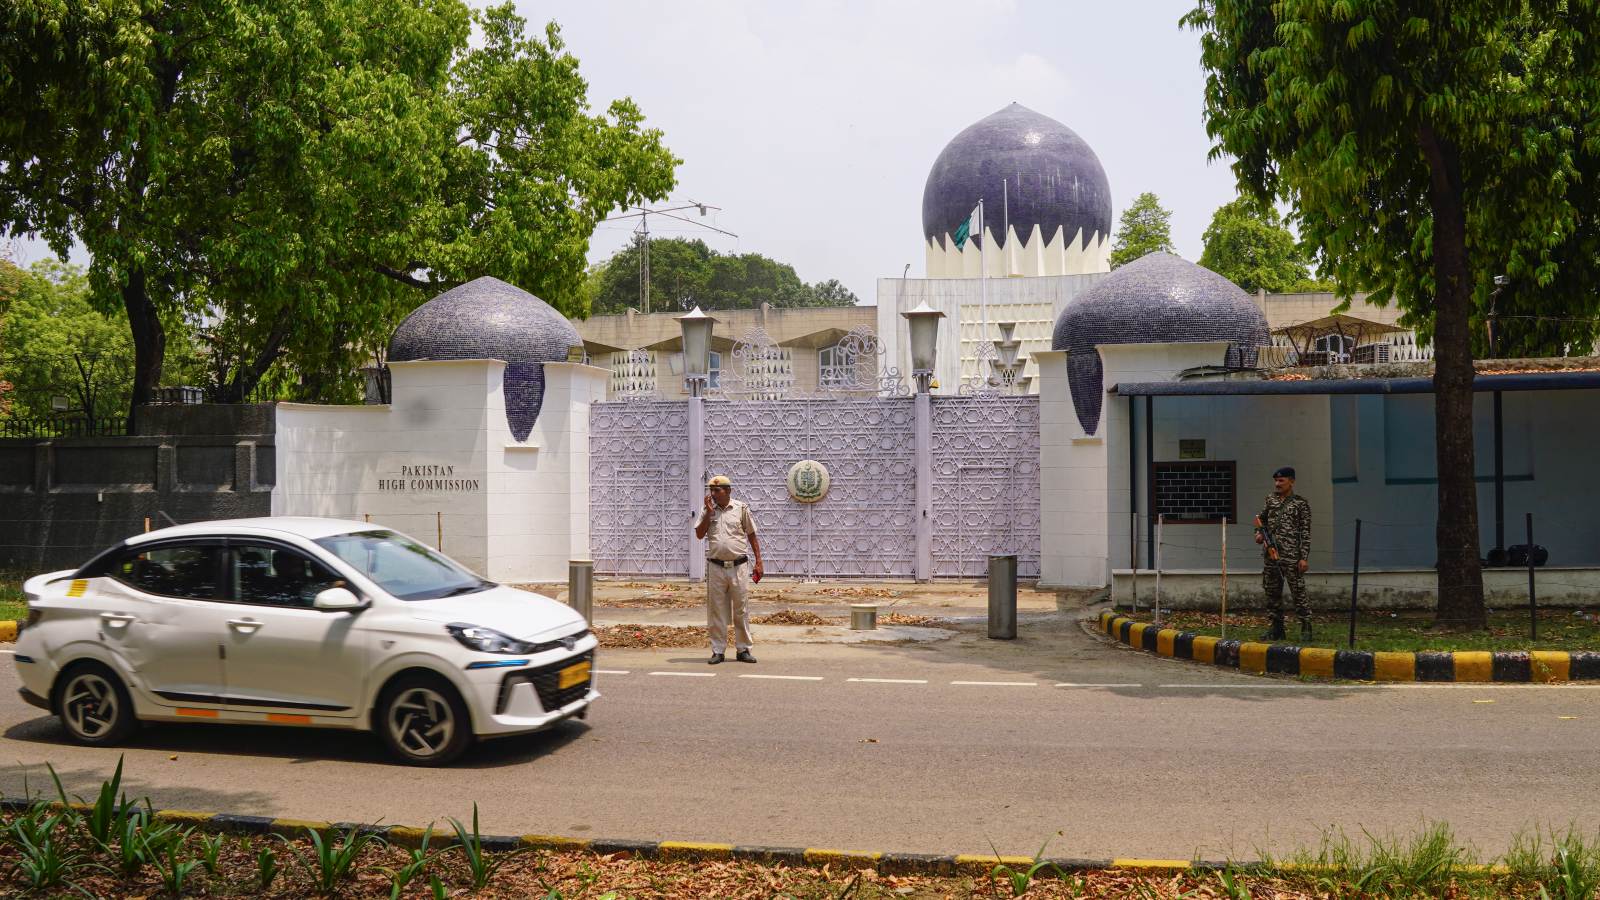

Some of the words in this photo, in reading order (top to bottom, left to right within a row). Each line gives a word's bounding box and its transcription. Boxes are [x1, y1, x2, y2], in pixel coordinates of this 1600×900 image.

[402, 465, 454, 476] PAKISTAN
[379, 479, 406, 491] HIGH
[411, 479, 480, 491] COMMISSION
